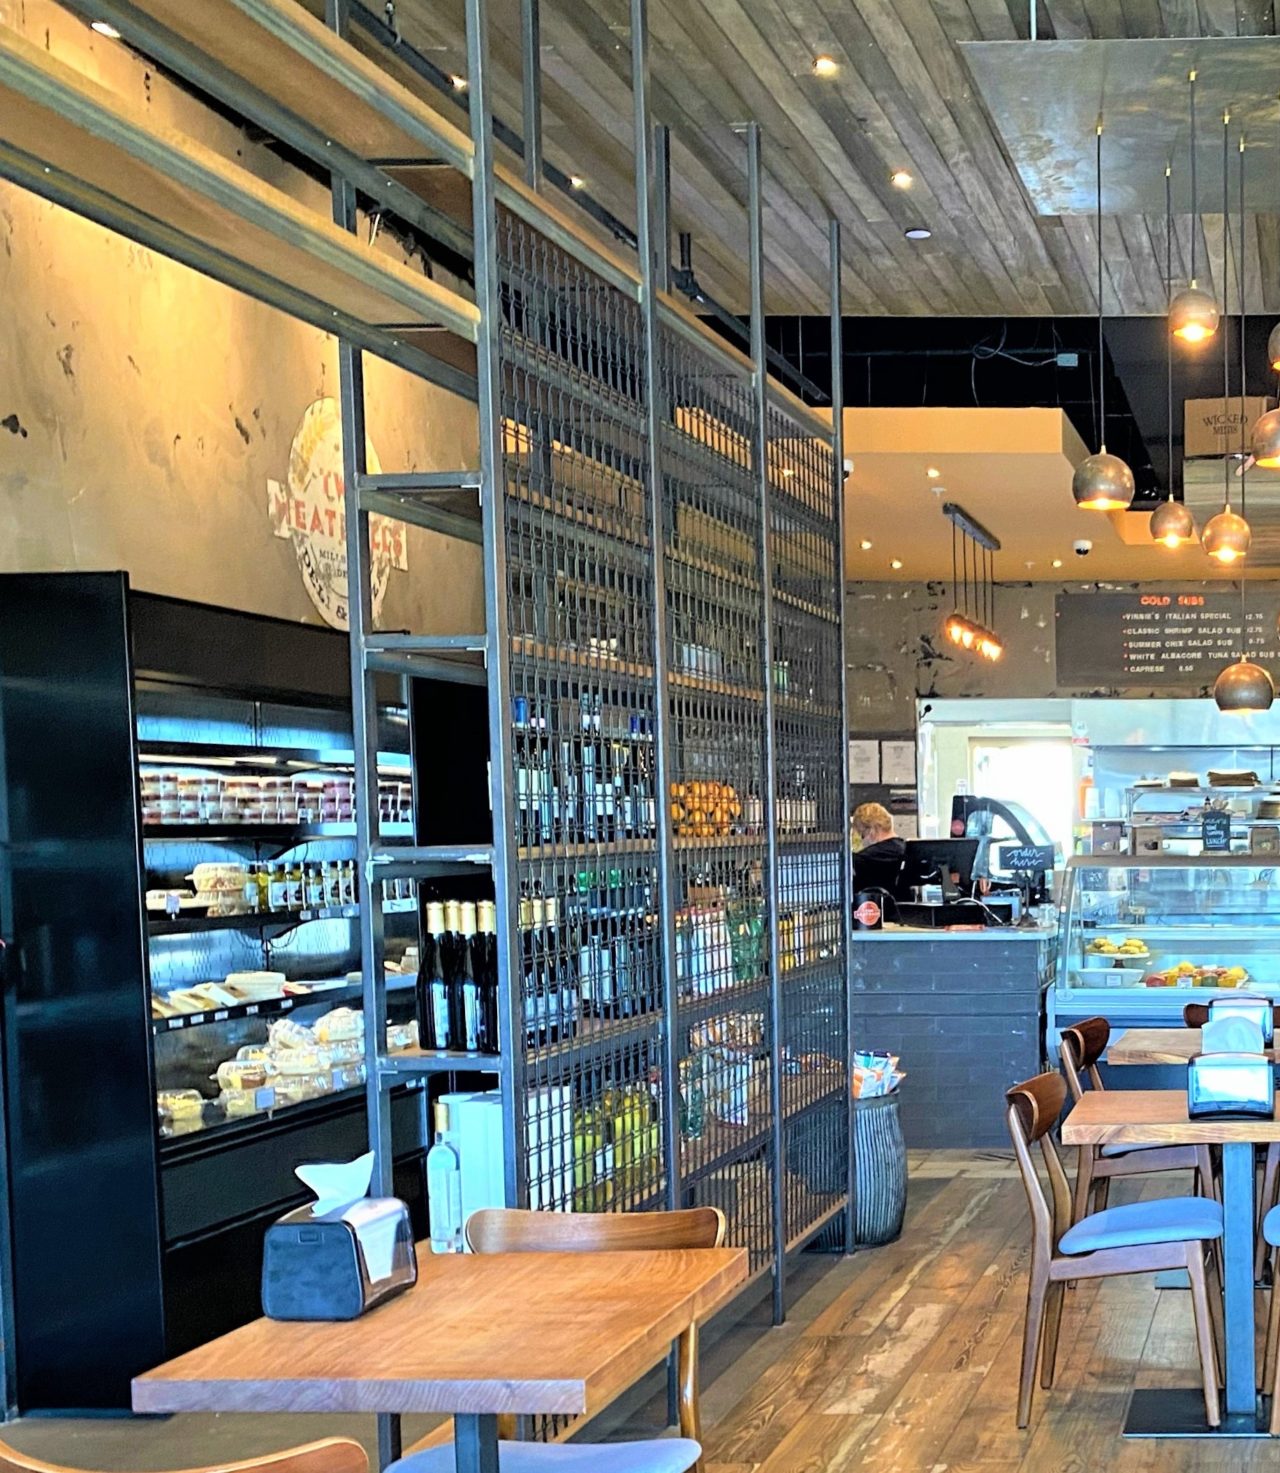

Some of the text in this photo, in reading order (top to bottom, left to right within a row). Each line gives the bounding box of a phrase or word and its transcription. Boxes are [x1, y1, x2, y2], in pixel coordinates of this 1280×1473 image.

[1140, 595, 1205, 606] COLD SUBS
[1165, 612, 1197, 620] ITALIAN
[1200, 612, 1232, 620] SPECIAL
[1127, 627, 1160, 635] CLASSIC
[1198, 627, 1223, 635] SALAD
[1187, 639, 1213, 647] SALAD
[1130, 665, 1165, 673] CAPRESE
